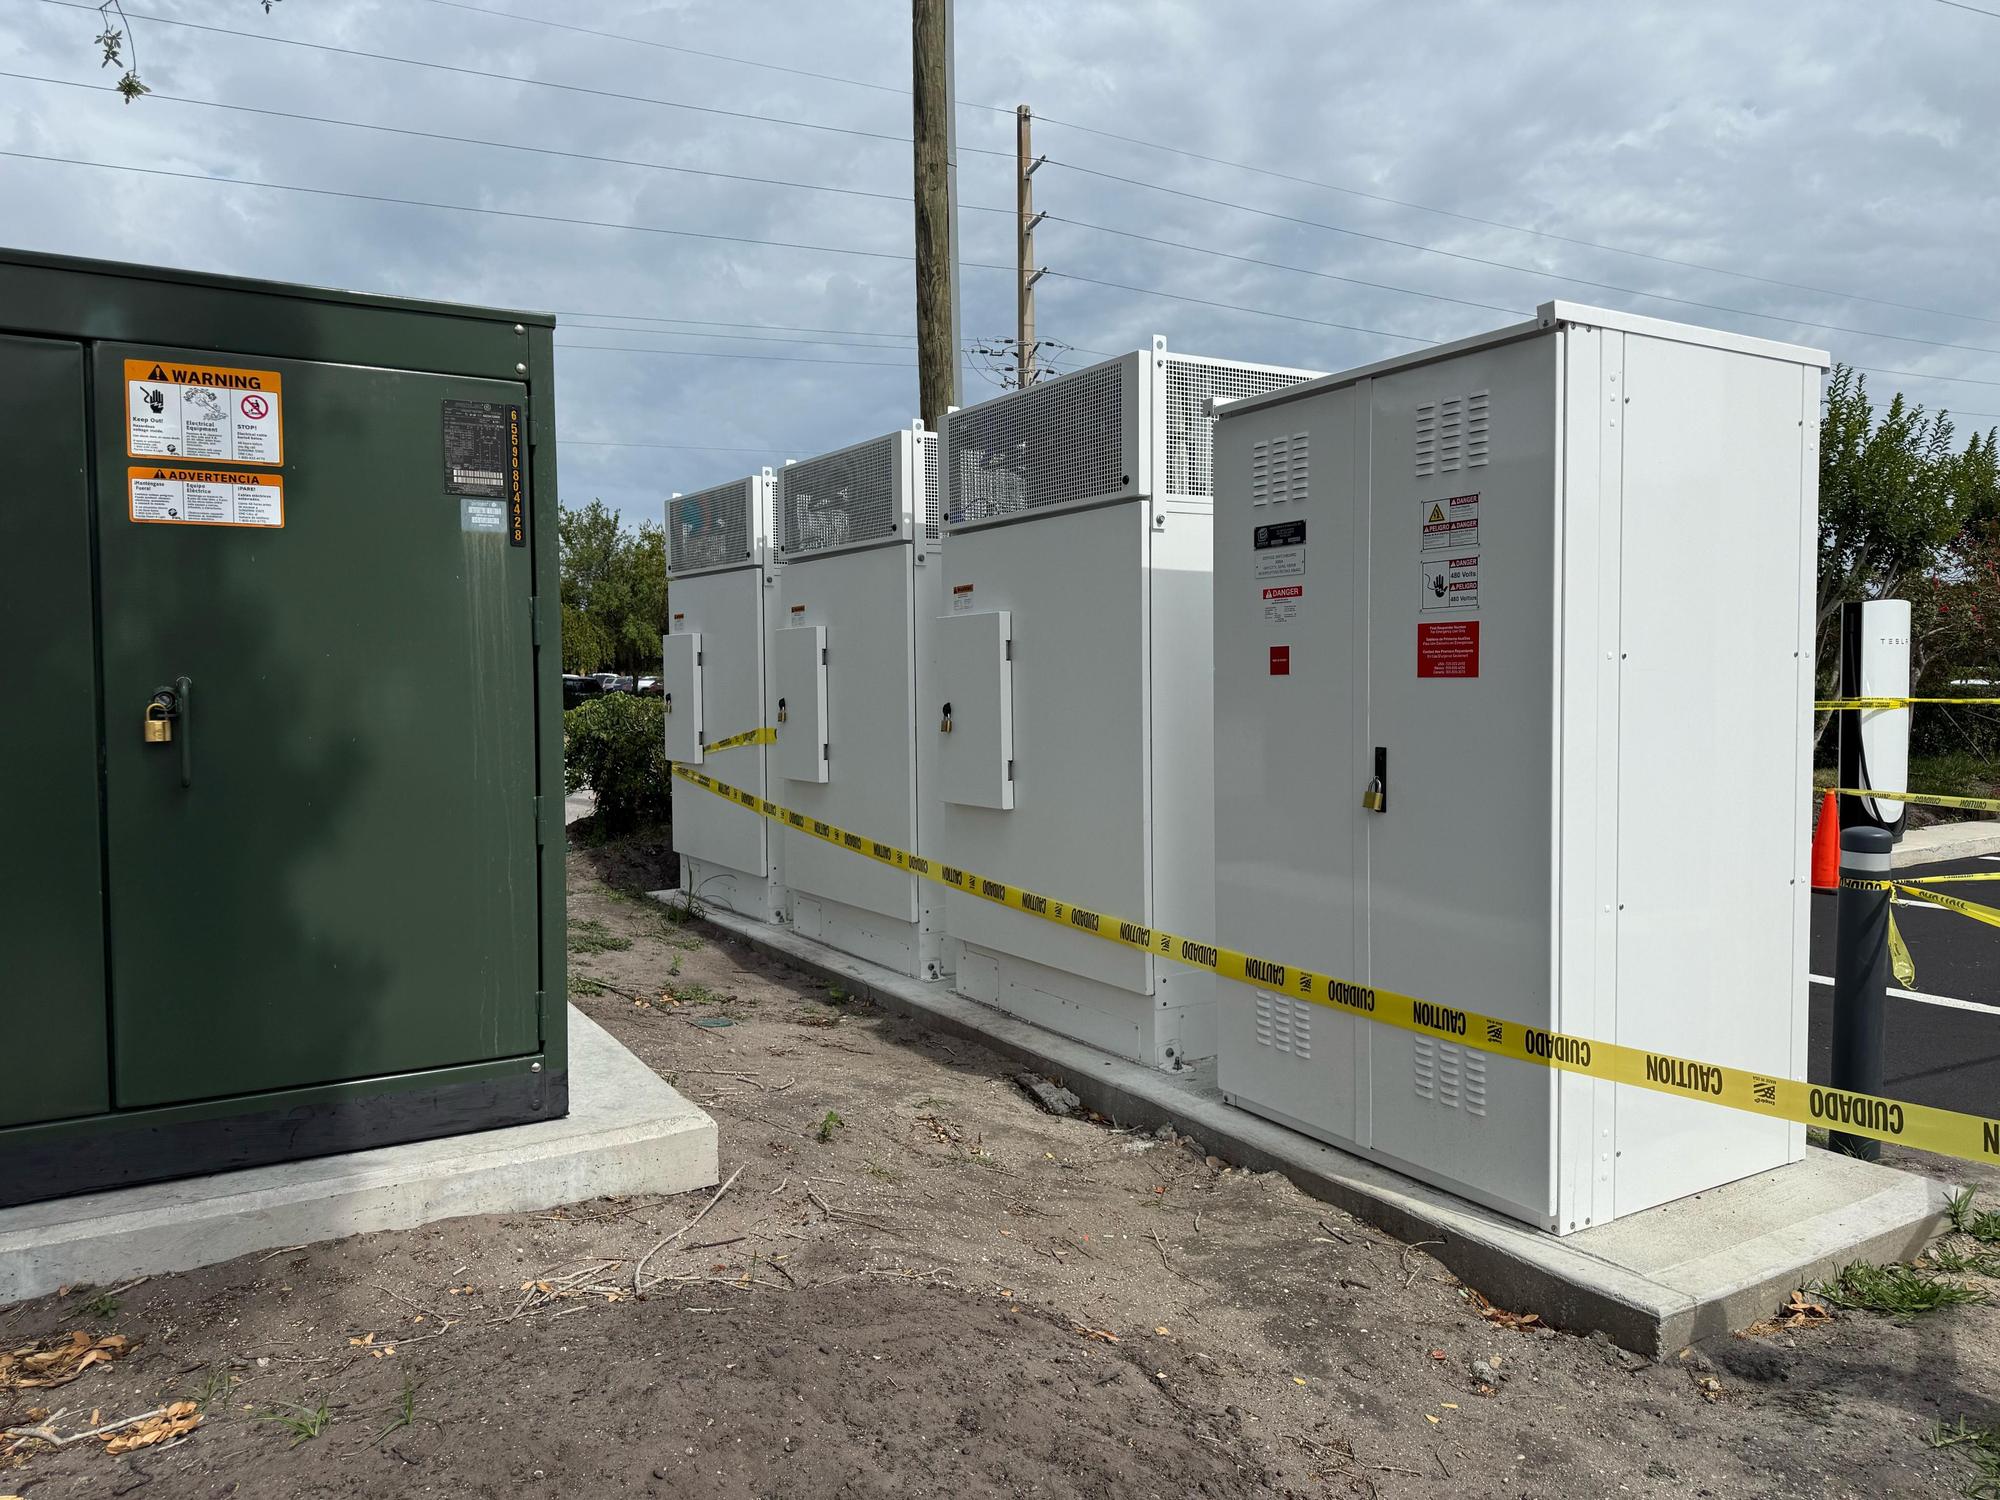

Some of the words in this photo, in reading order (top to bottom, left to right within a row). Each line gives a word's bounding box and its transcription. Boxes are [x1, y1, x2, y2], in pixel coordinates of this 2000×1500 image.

[172, 369, 261, 389] WARNING
[133, 416, 148, 424] Keep
[169, 469, 260, 484] ADVERTENCIA
[1457, 496, 1477, 504] DANGER
[1272, 588, 1299, 597] DANGER
[815, 821, 829, 837] CAUTION
[845, 833, 861, 849] CUIDADO
[874, 844, 891, 859] CAUTION
[909, 855, 928, 875] CUIDADO
[943, 868, 962, 885] CAUTION
[983, 880, 1005, 900] CUIDADO
[1022, 893, 1046, 914] CAUTION
[1071, 908, 1099, 930] CUIDADO
[1119, 921, 1150, 946] CAUTION
[1182, 941, 1217, 967] CUIDADO
[1245, 957, 1285, 986] CAUTION
[1328, 979, 1375, 1012] CUIDADO
[1414, 1001, 1466, 1035] CAUTION
[1525, 1029, 1591, 1066] CUIDADO
[1646, 1055, 1723, 1095] CAUTION
[1810, 1088, 1904, 1134] CUIDADO
